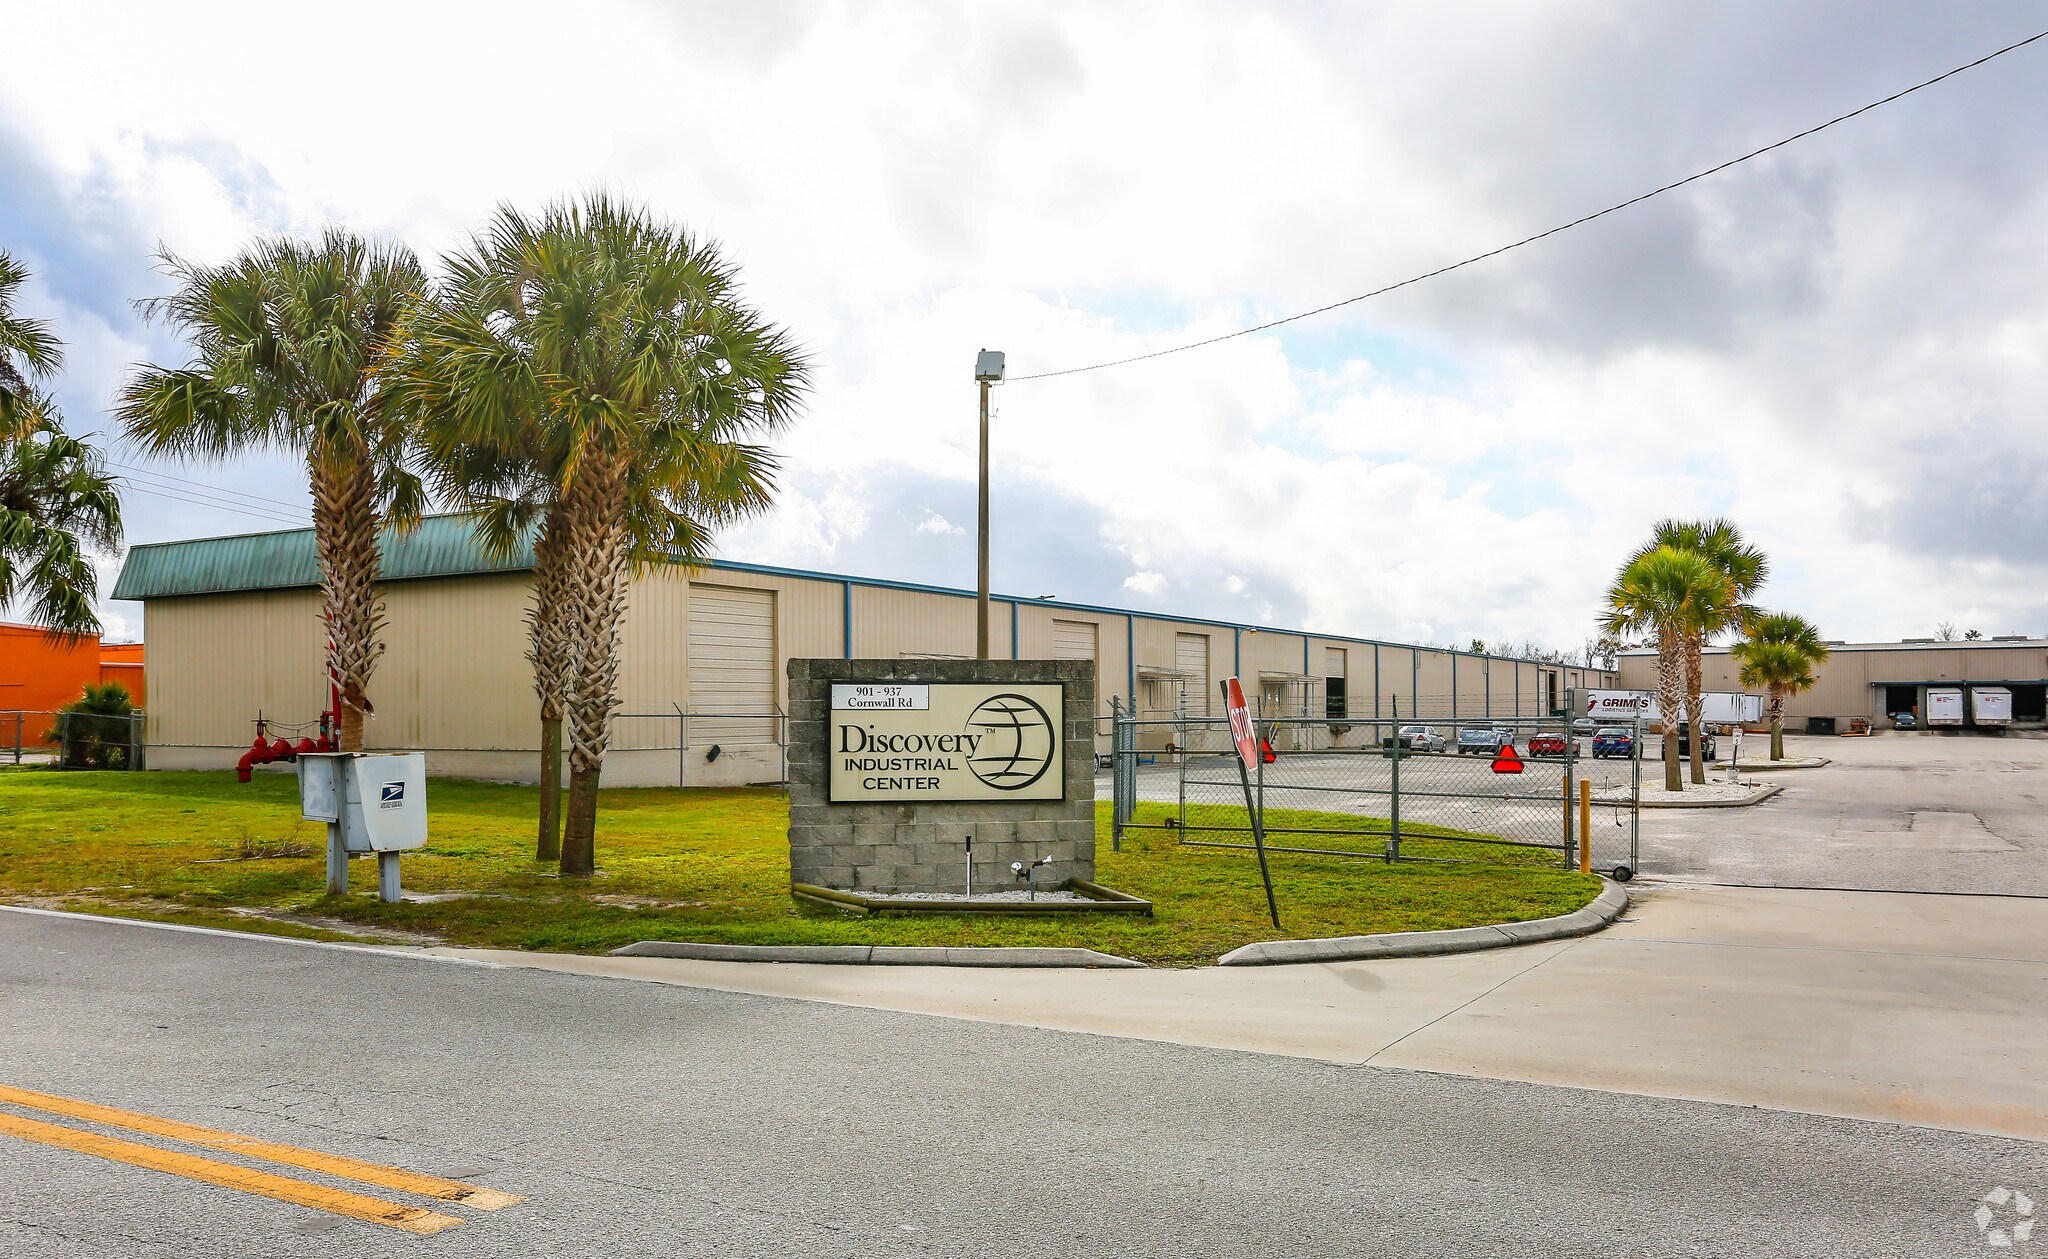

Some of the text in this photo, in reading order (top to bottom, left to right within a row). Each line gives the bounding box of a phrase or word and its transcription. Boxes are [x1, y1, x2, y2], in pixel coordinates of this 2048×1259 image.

[856, 687, 874, 696] 901
[884, 687, 902, 696] 937
[848, 697, 912, 707] Cornwall Rd
[1231, 705, 1252, 742] STOP
[838, 724, 983, 759] Discovery
[844, 758, 959, 771] INDUSTRIAL
[862, 777, 940, 790] CENTER
